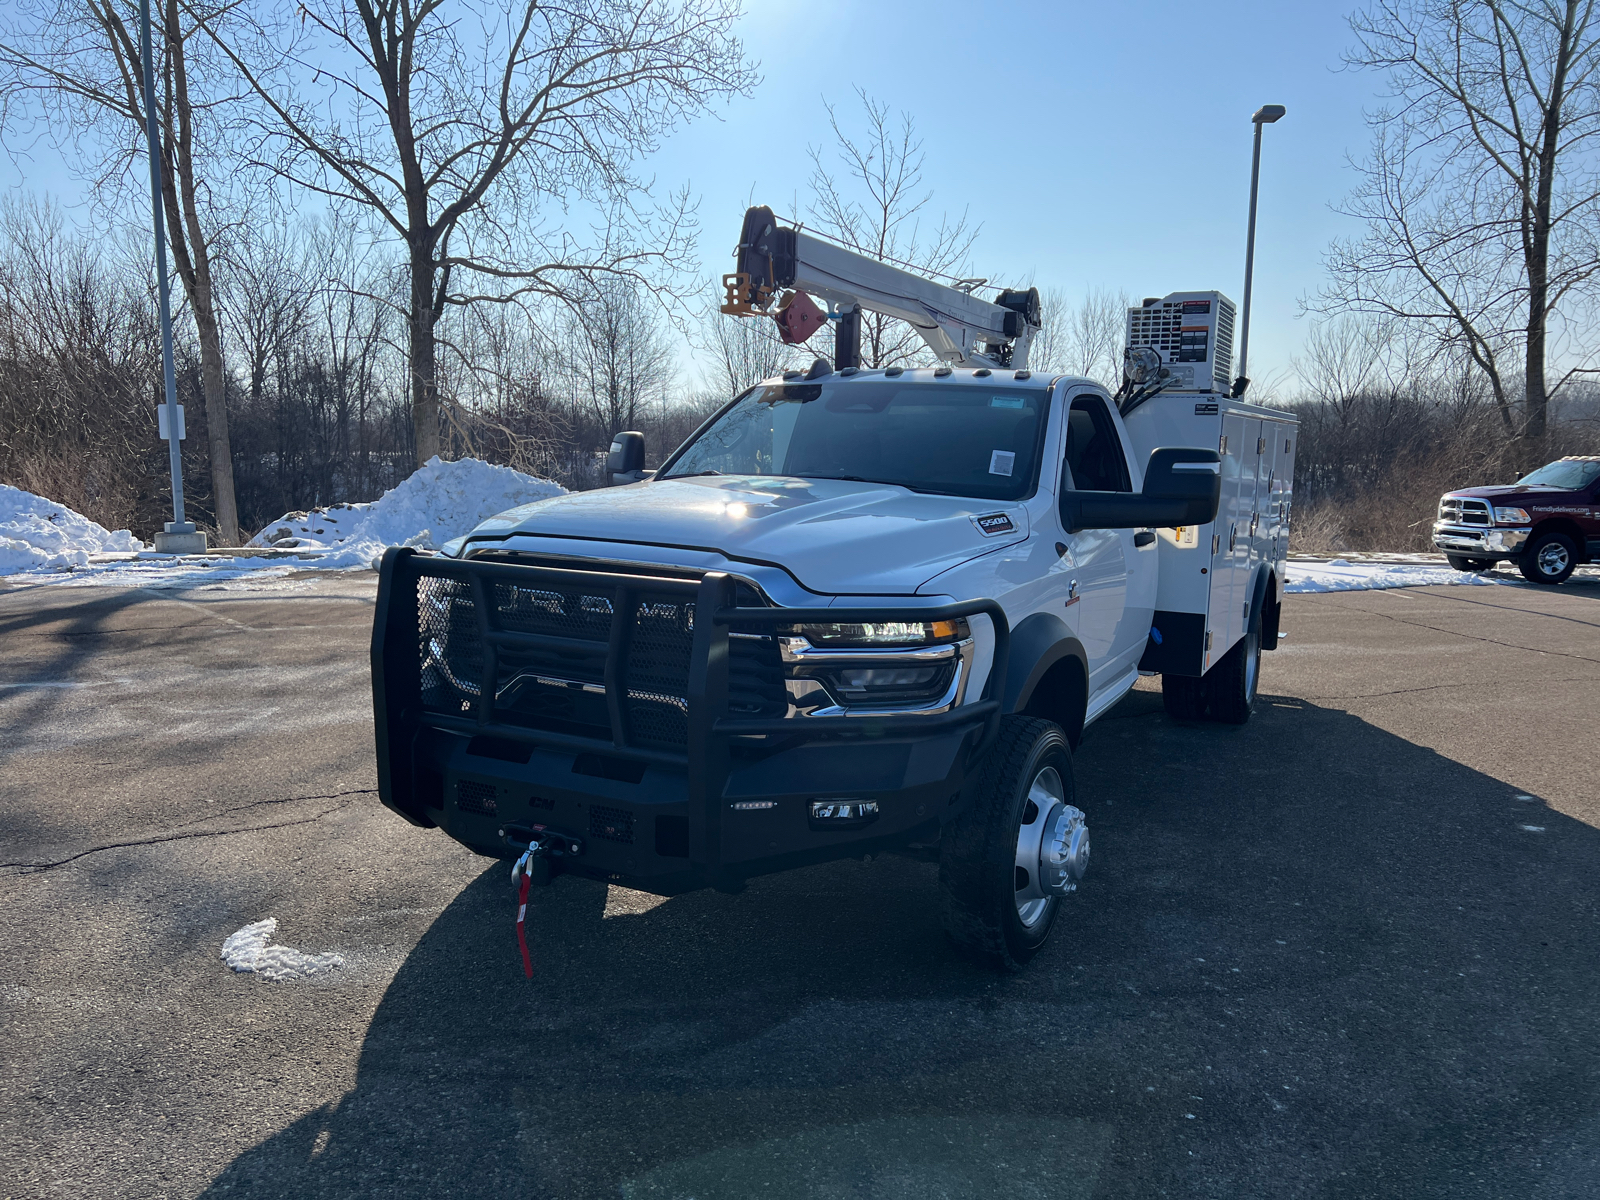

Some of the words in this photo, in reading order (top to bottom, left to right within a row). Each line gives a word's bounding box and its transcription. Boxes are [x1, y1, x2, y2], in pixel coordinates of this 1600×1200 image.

[1532, 505, 1590, 513] Friendlydelivers.com
[980, 516, 1008, 527] 5500
[528, 796, 556, 811] CM
